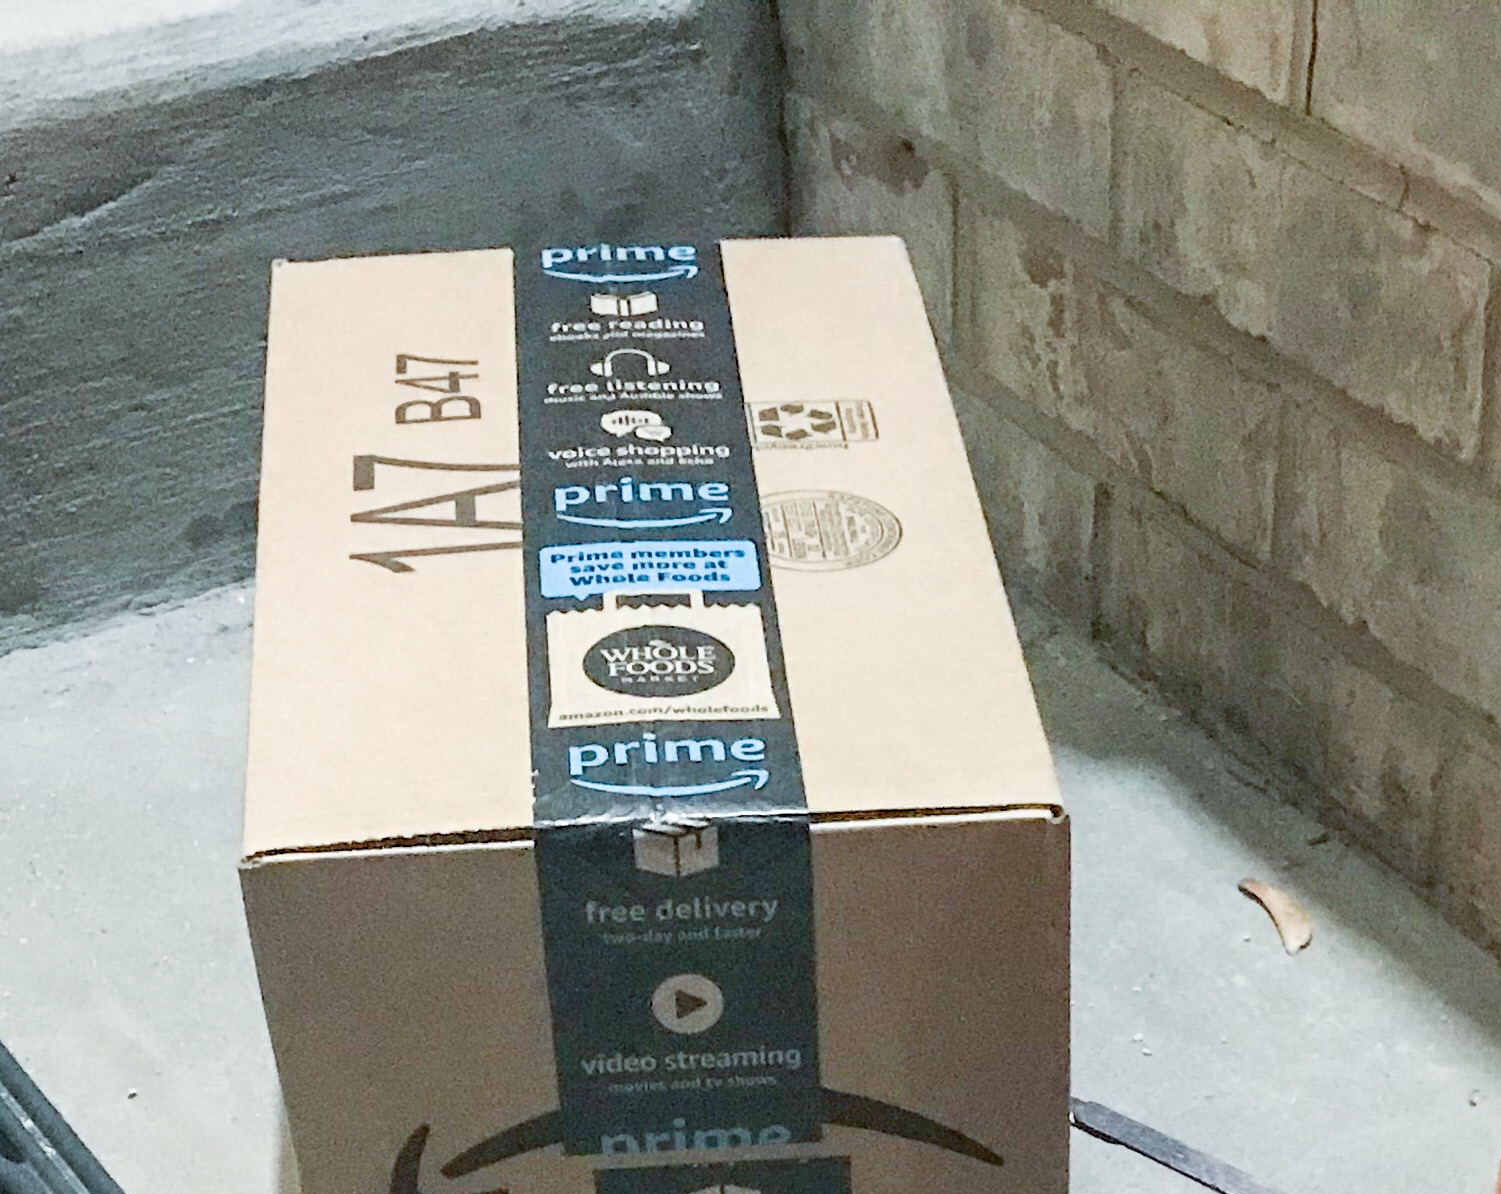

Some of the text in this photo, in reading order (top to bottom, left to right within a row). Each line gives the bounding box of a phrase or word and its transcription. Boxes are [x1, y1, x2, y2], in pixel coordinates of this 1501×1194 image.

[542, 243, 696, 268] prime
[551, 318, 704, 333] free reading
[395, 354, 482, 424] B47
[547, 379, 720, 394] free listening
[548, 443, 730, 460] voice shopping
[554, 476, 730, 512] prime
[550, 549, 746, 563] Prime members
[570, 560, 729, 573] save more at
[569, 571, 731, 586] Whole Foods
[600, 645, 717, 663] WHOLE
[608, 658, 716, 677] FOODS
[558, 704, 769, 721] amazon.com/wholefoods
[568, 733, 766, 775] prime
[585, 896, 778, 923] free delivery
[580, 1045, 802, 1075] video streaming
